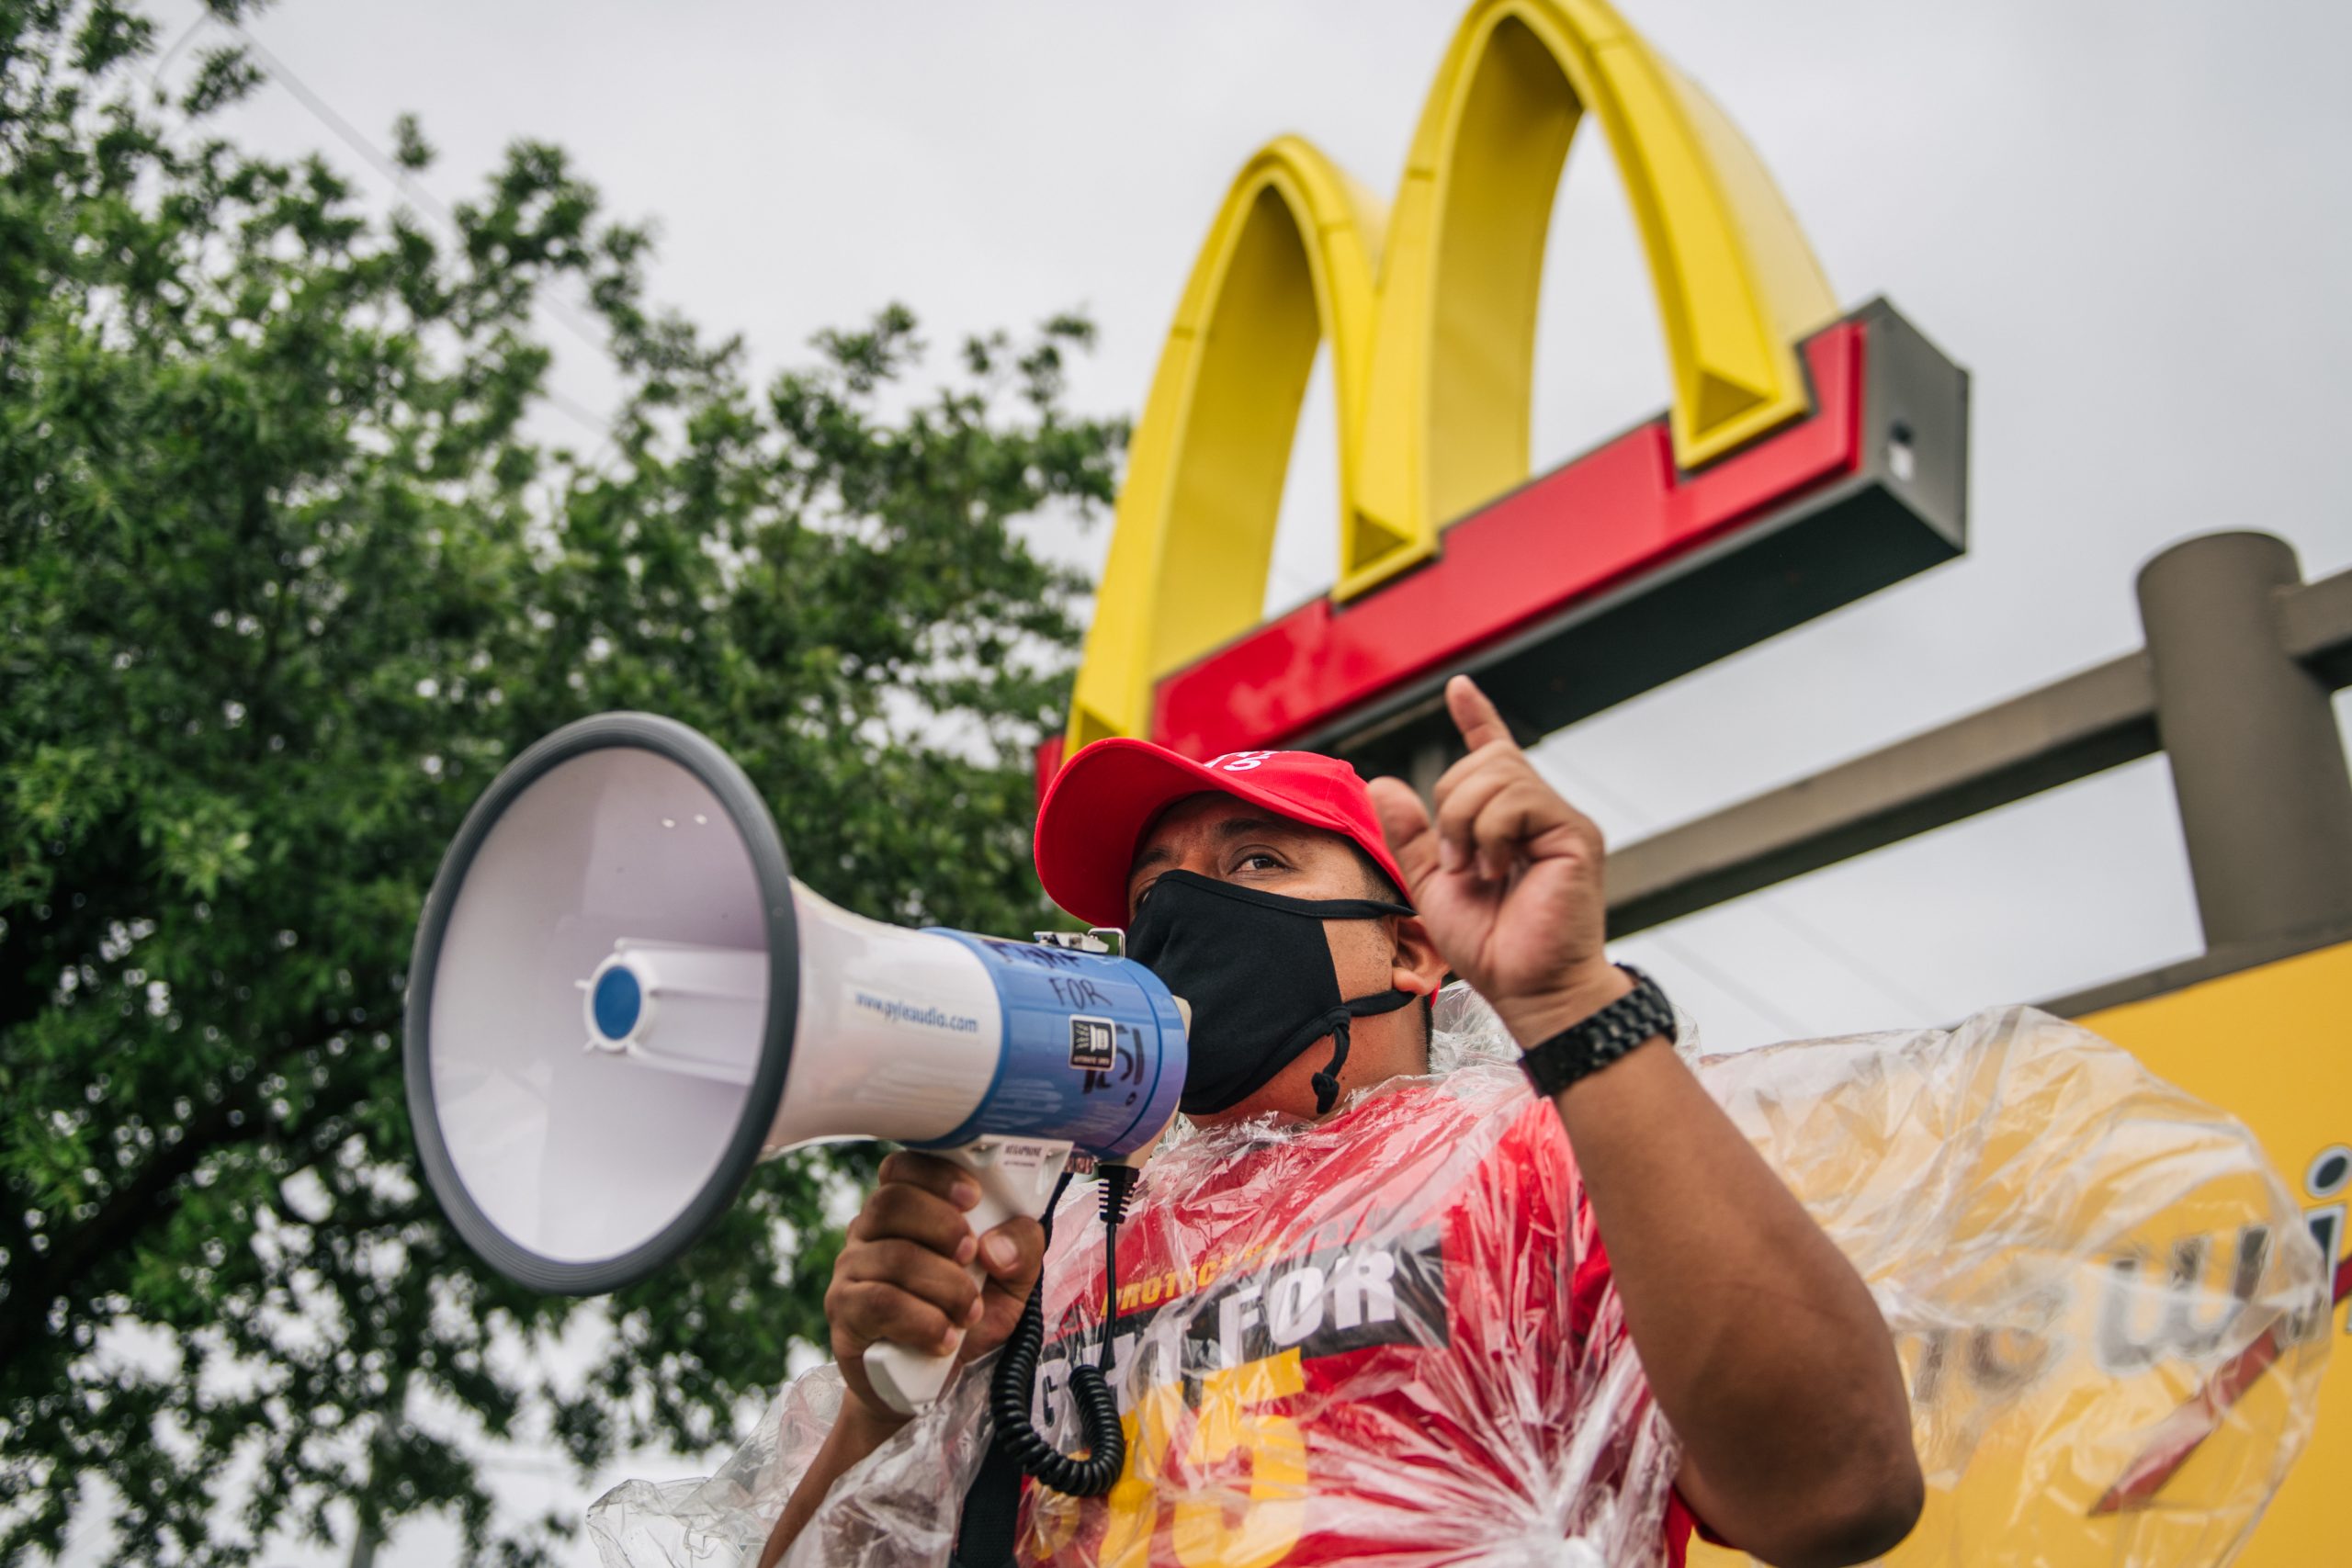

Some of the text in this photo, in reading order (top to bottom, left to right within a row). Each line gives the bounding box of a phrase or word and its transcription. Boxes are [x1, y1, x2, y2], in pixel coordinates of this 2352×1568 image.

[855, 993, 978, 1032] www.pyleaudio.com
[1048, 976, 1113, 1010] FOR
[1219, 1250, 1396, 1369] FOR
